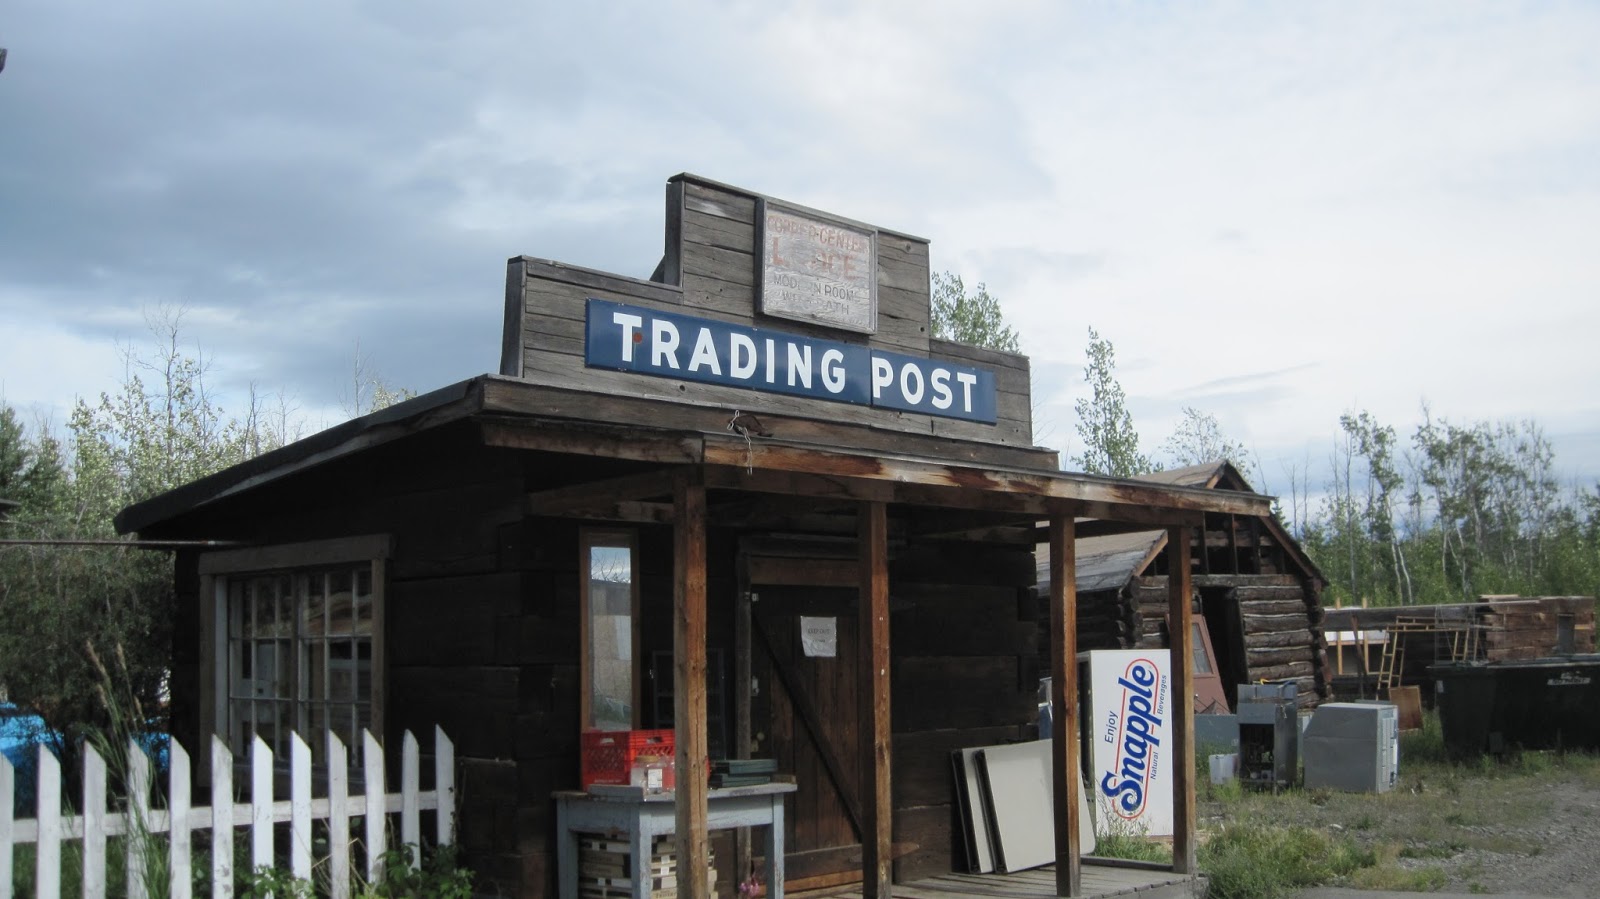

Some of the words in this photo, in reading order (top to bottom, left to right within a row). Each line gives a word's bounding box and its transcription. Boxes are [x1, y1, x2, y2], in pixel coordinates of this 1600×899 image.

[773, 273, 821, 294] MODN
[824, 284, 859, 302] ROOM
[818, 300, 850, 315] ATH
[613, 312, 846, 394] TRADING
[872, 357, 977, 413] POST
[1101, 665, 1162, 812] Snapple
[1105, 711, 1118, 744] Enjoy
[1151, 752, 1159, 780] Natural
[1157, 675, 1167, 715] Beverages
